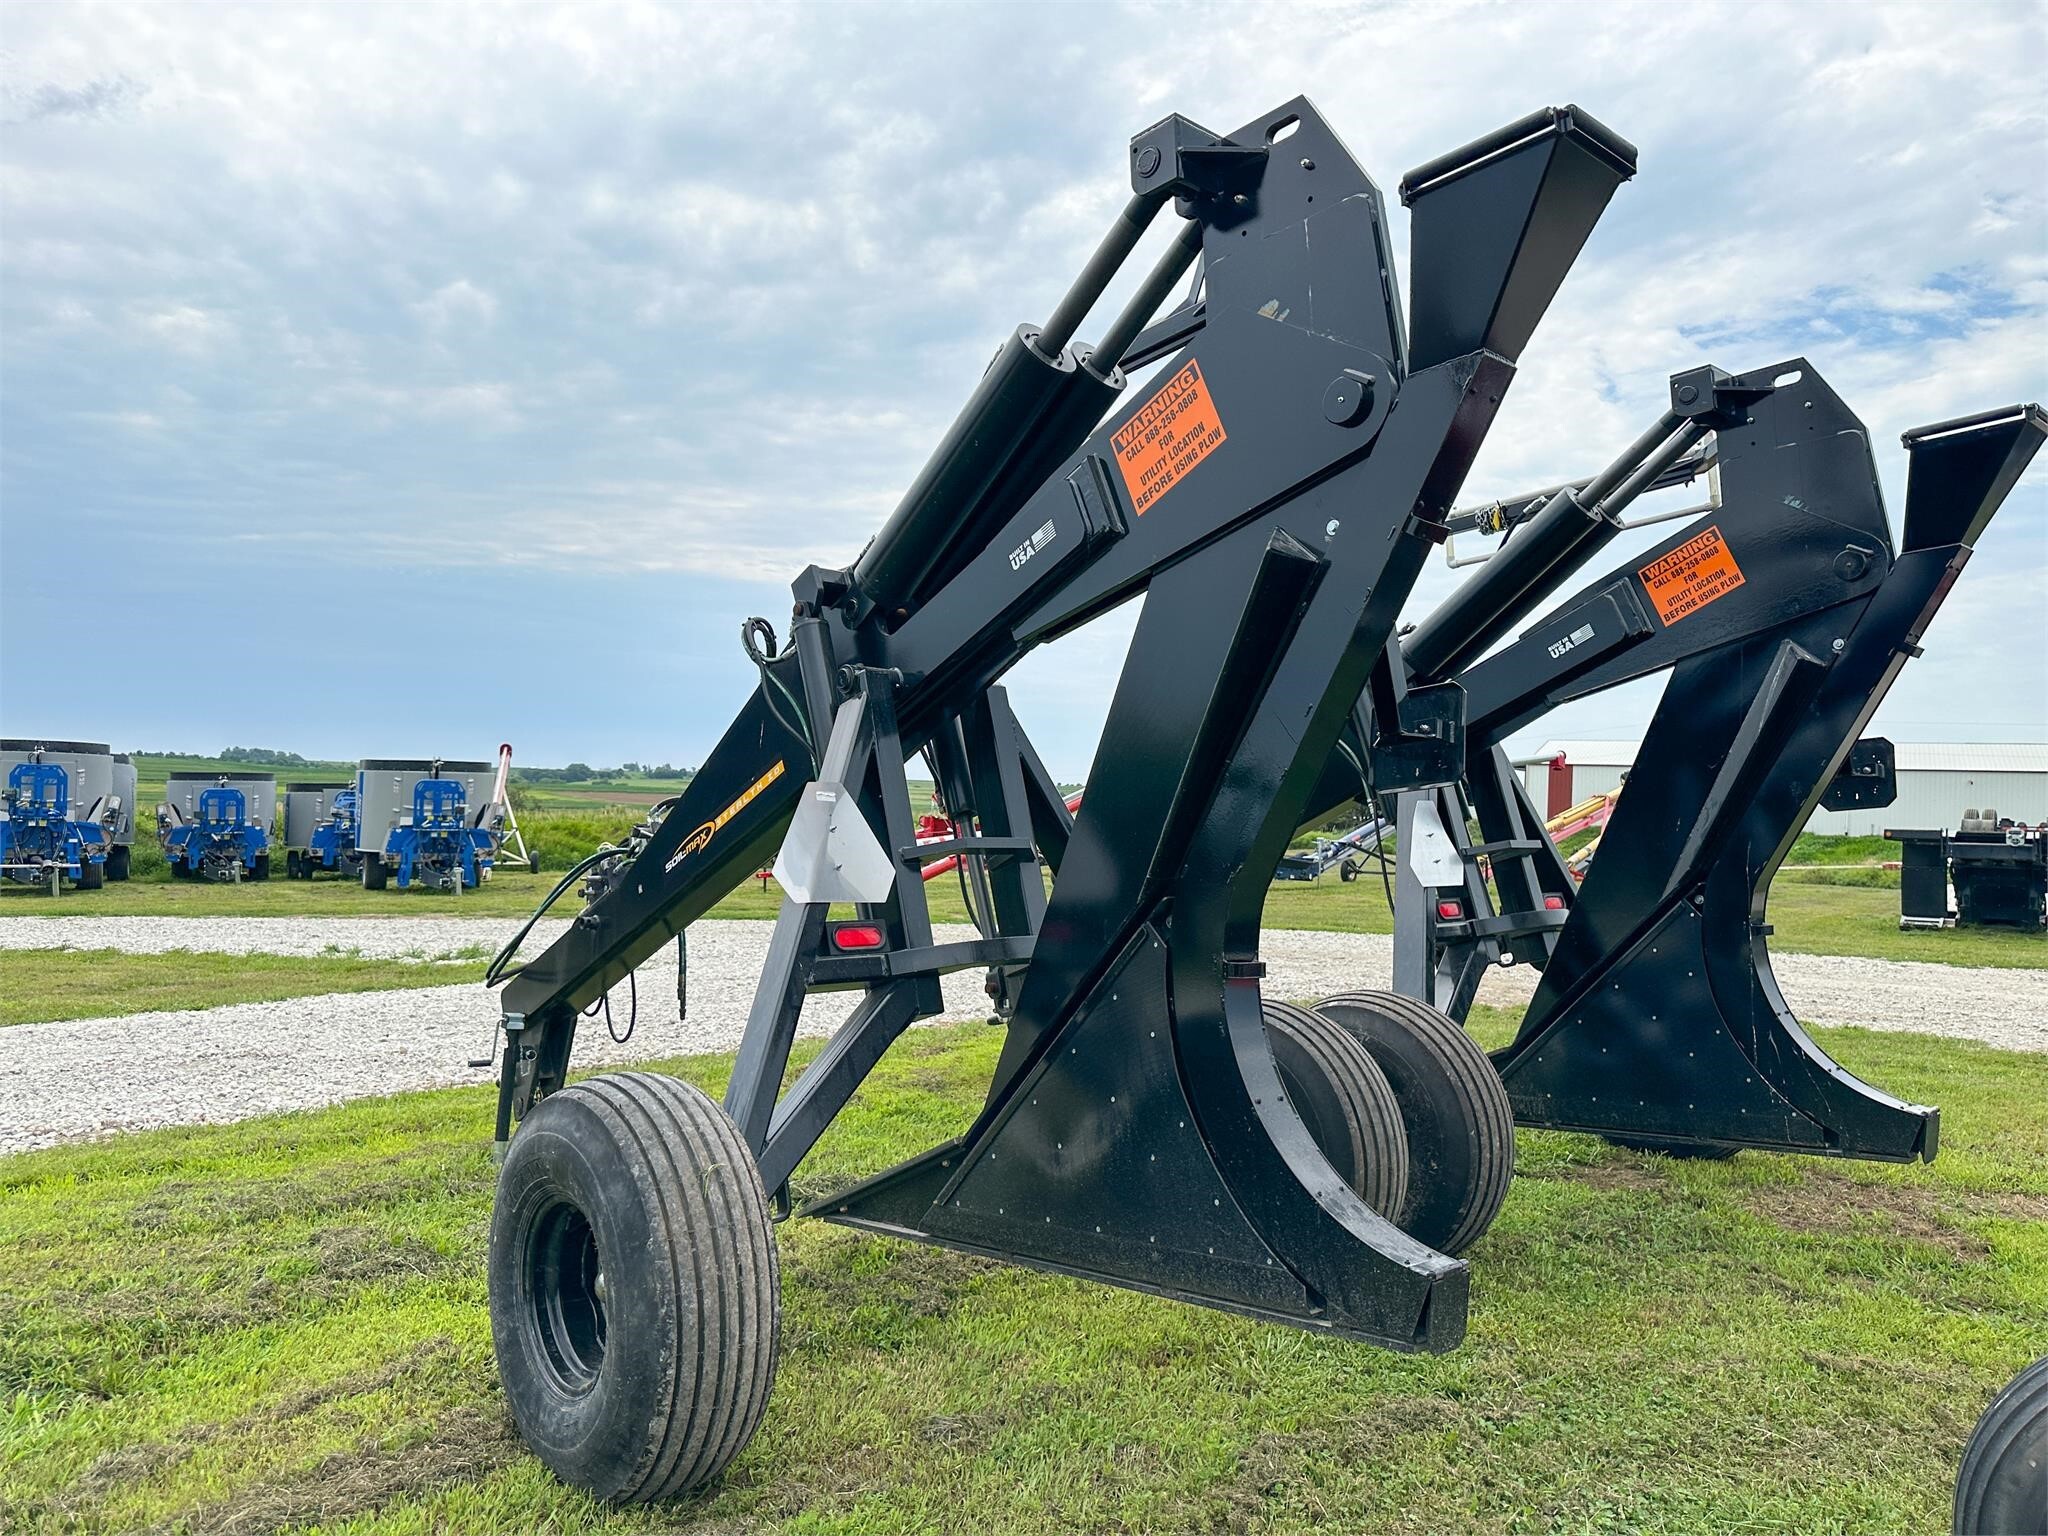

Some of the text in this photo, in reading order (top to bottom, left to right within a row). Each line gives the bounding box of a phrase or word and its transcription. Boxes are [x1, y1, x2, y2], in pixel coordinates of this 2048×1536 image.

[1116, 369, 1196, 448] WARNING
[1125, 389, 1198, 462] CALL 888-258-0808
[1140, 421, 1205, 486] UTILITY LOCATION
[1158, 430, 1175, 450] FOR
[1136, 427, 1222, 509] BEFORE USING PLOW
[1010, 545, 1036, 571] USA
[1645, 532, 1716, 580] WARNING
[1653, 545, 1720, 589] CALL 888-258-0808
[1683, 571, 1699, 585] FOR
[1663, 573, 1741, 622] BEFORE USING PLOW
[1666, 568, 1727, 607] UTILITY LOCATION
[1550, 641, 1575, 659] USA
